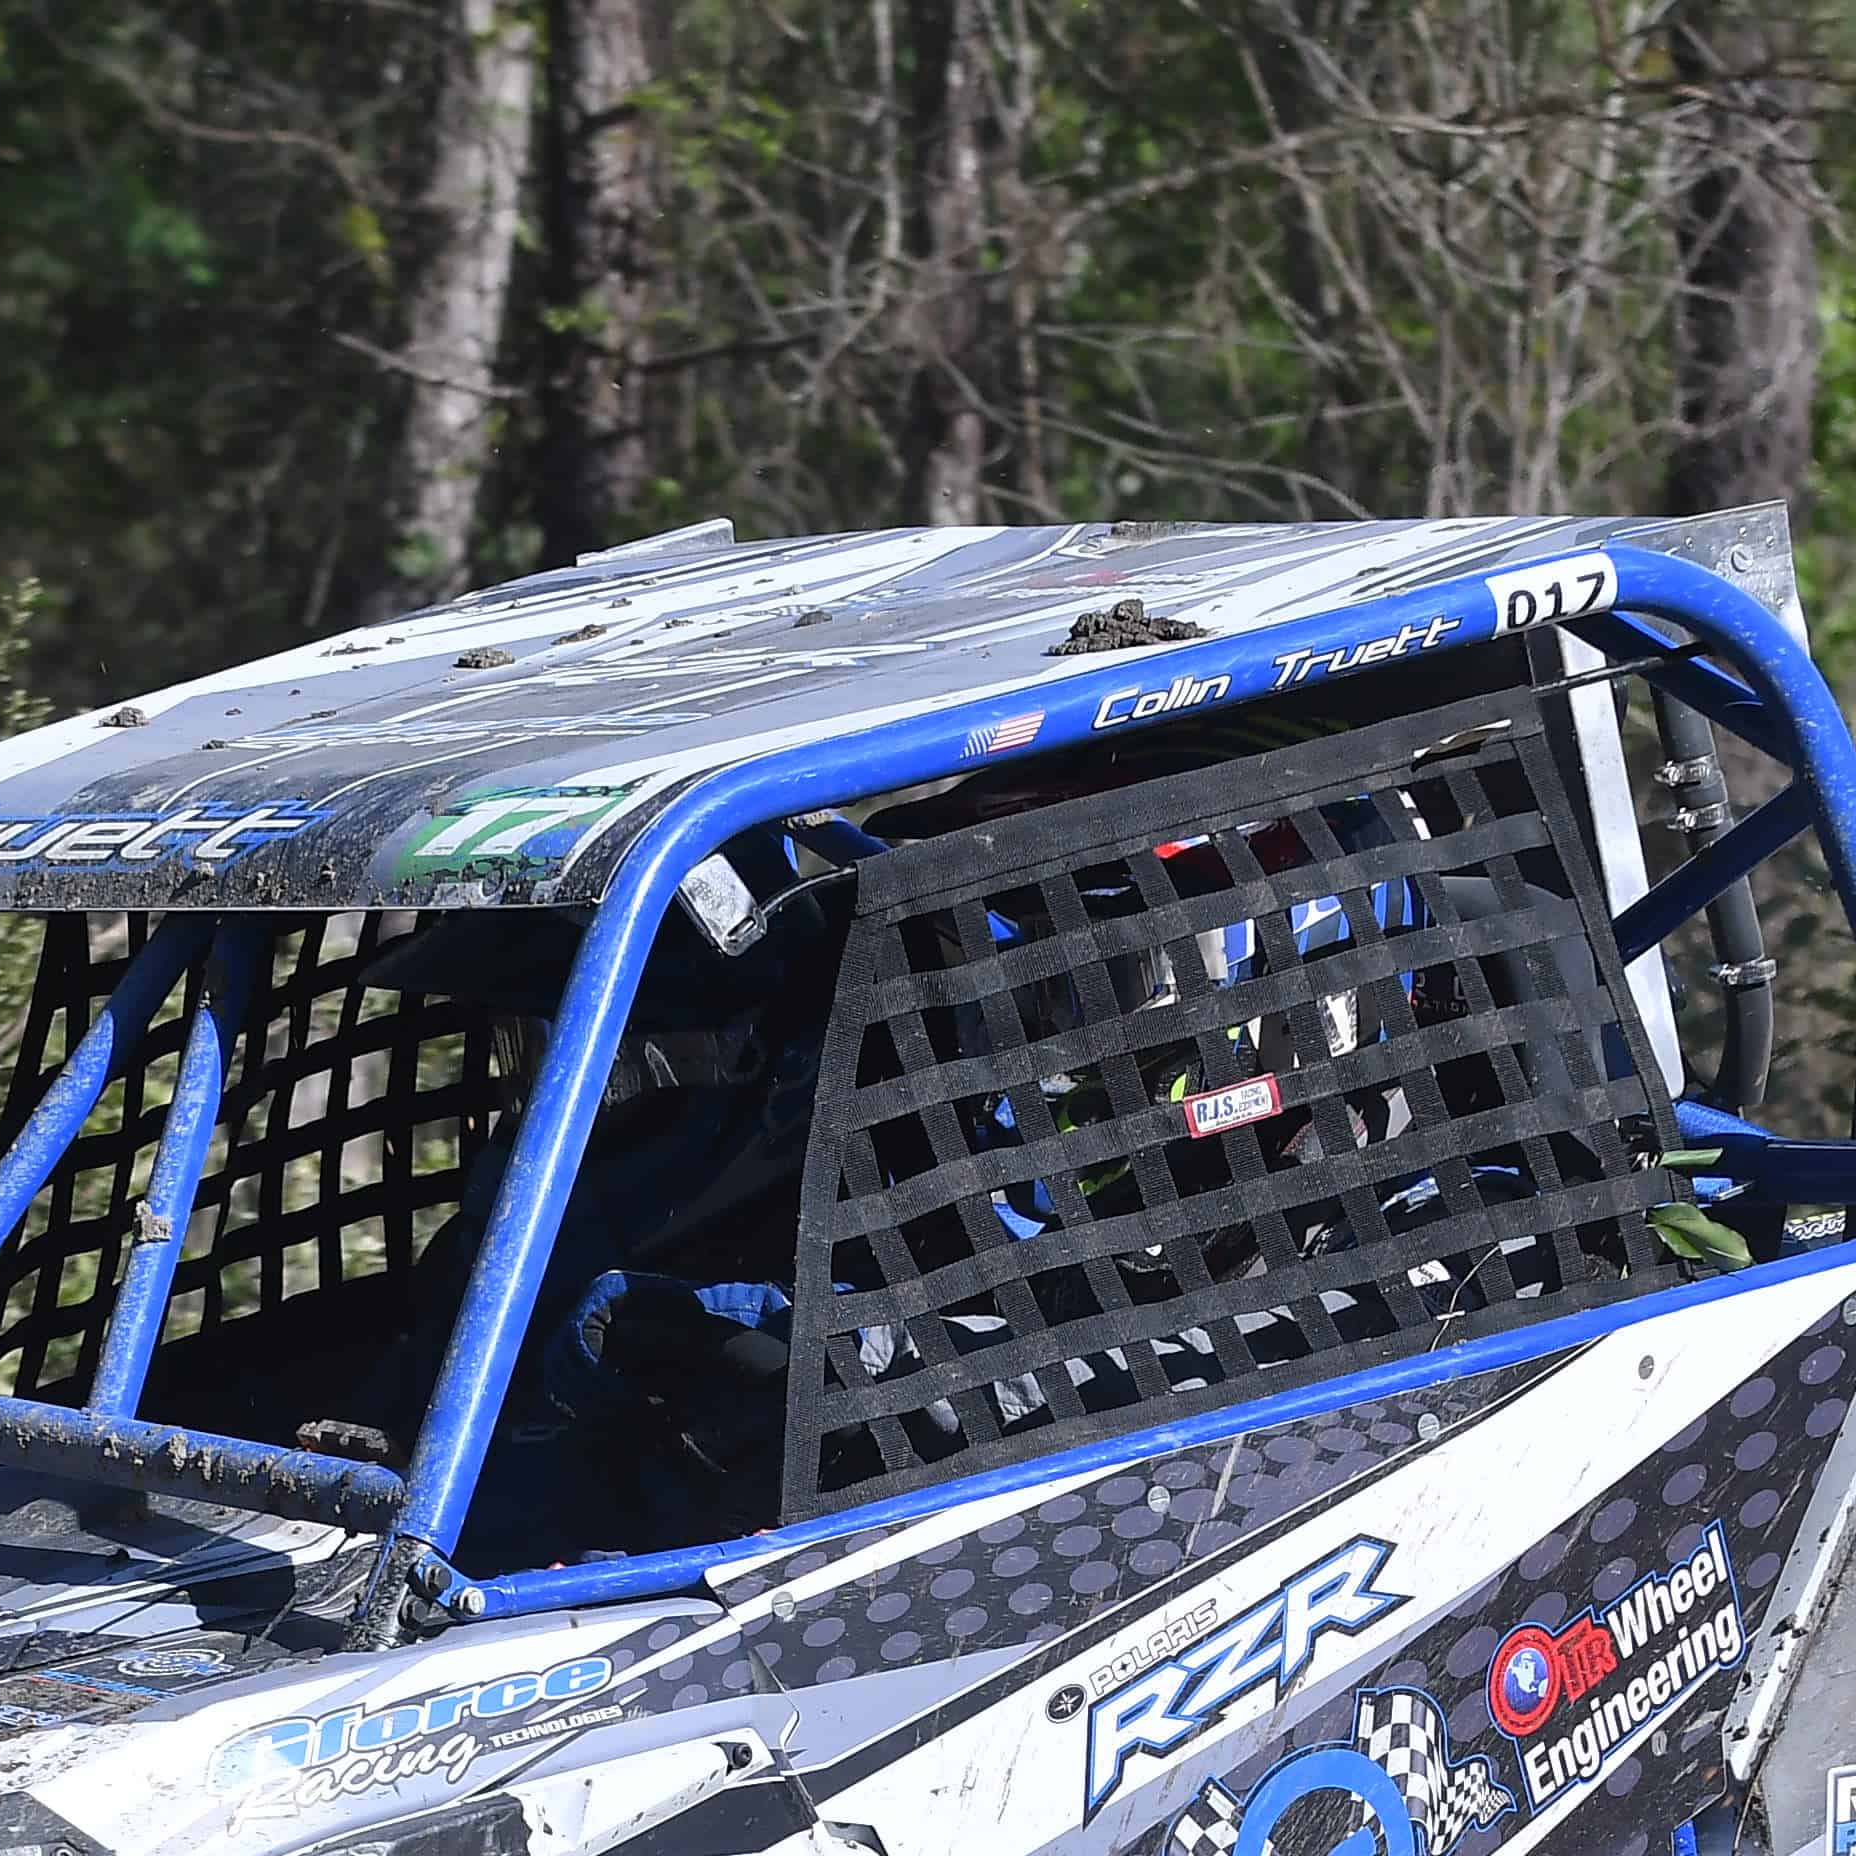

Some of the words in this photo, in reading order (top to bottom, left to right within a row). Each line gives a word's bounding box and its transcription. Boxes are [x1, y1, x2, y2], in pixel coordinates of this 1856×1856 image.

[1506, 571, 1608, 630] 017
[1093, 675, 1232, 730] Collin
[1272, 617, 1463, 688] Truett
[1089, 1601, 1219, 1697] POLARIS
[1607, 1529, 1728, 1659] Wheel
[489, 1704, 624, 1749] TECHNOLOGIES
[1085, 1536, 1408, 1824] RZR
[1523, 1602, 1742, 1804] Engineering
